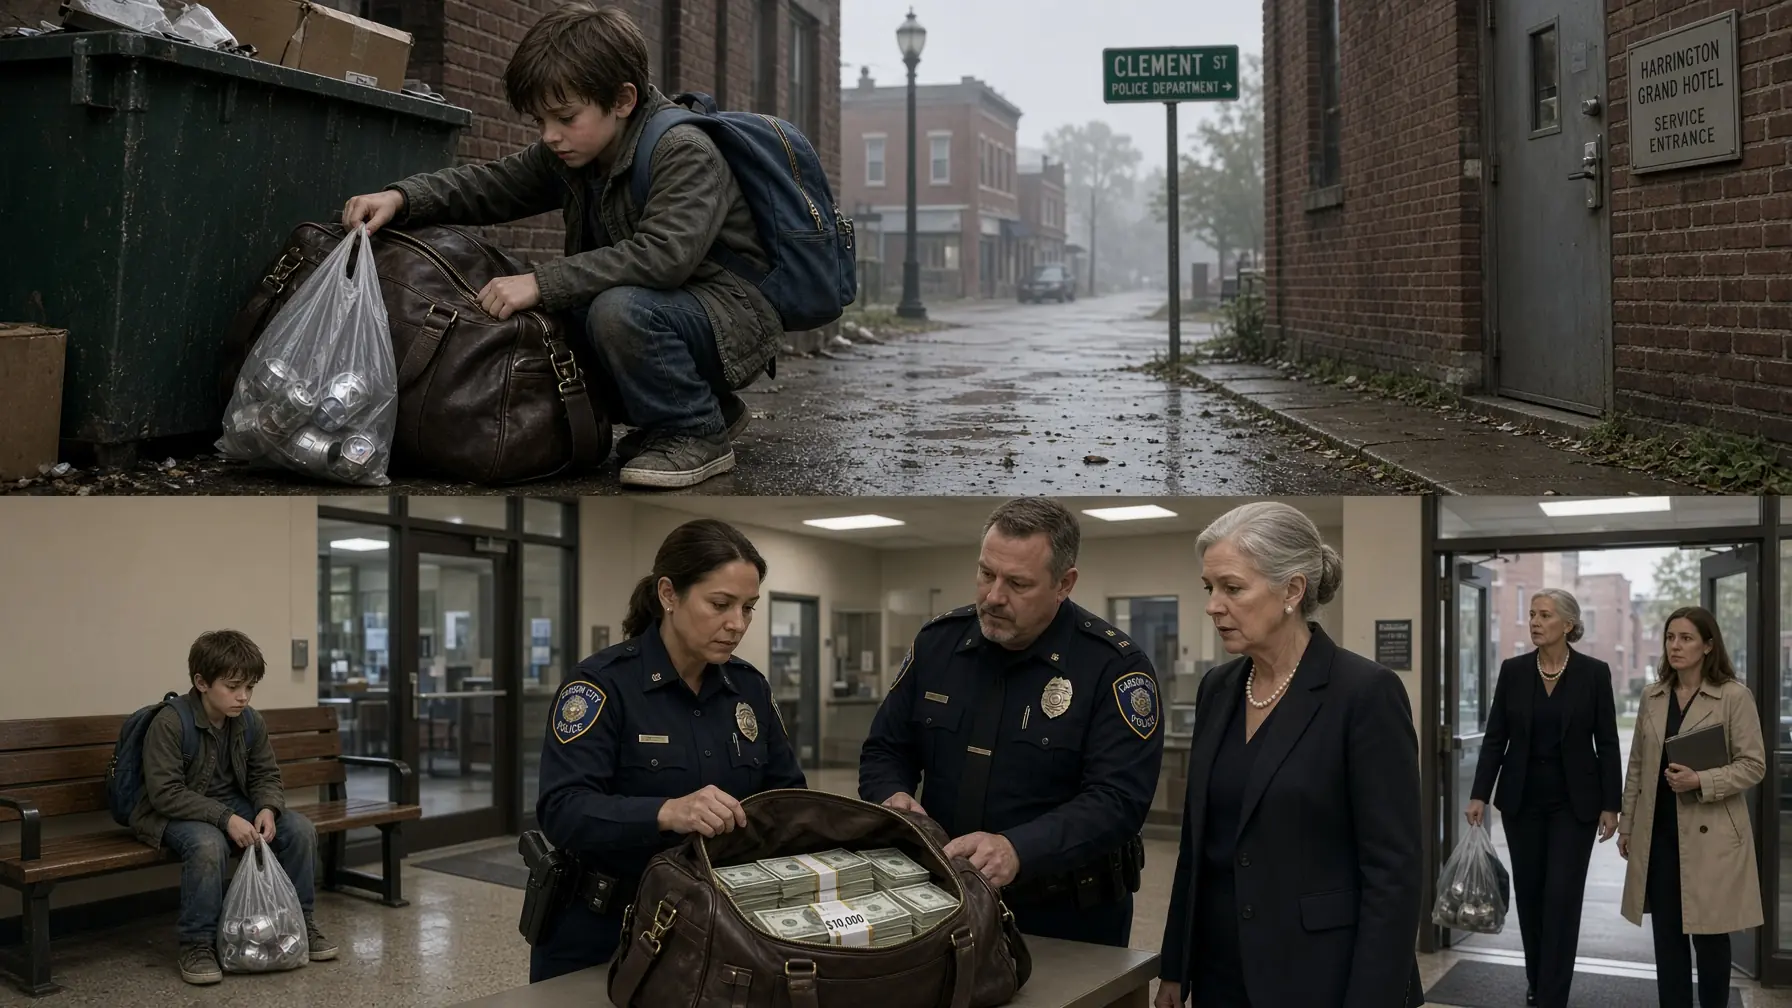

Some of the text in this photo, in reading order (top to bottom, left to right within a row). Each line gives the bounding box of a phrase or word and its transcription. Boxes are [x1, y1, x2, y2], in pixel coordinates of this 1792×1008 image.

[1114, 53, 1228, 77] CLEMENT ST
[1641, 39, 1720, 80] HARRINGTON
[1111, 80, 1220, 96] POLICE DEPARTMENT
[1638, 67, 1724, 105] GRAND HOTEL
[1654, 107, 1706, 132] SERVICE
[1649, 126, 1716, 153] ENTRANCE
[585, 688, 602, 703] CITY
[556, 720, 584, 734] POLICE
[825, 913, 865, 931] $10,000
